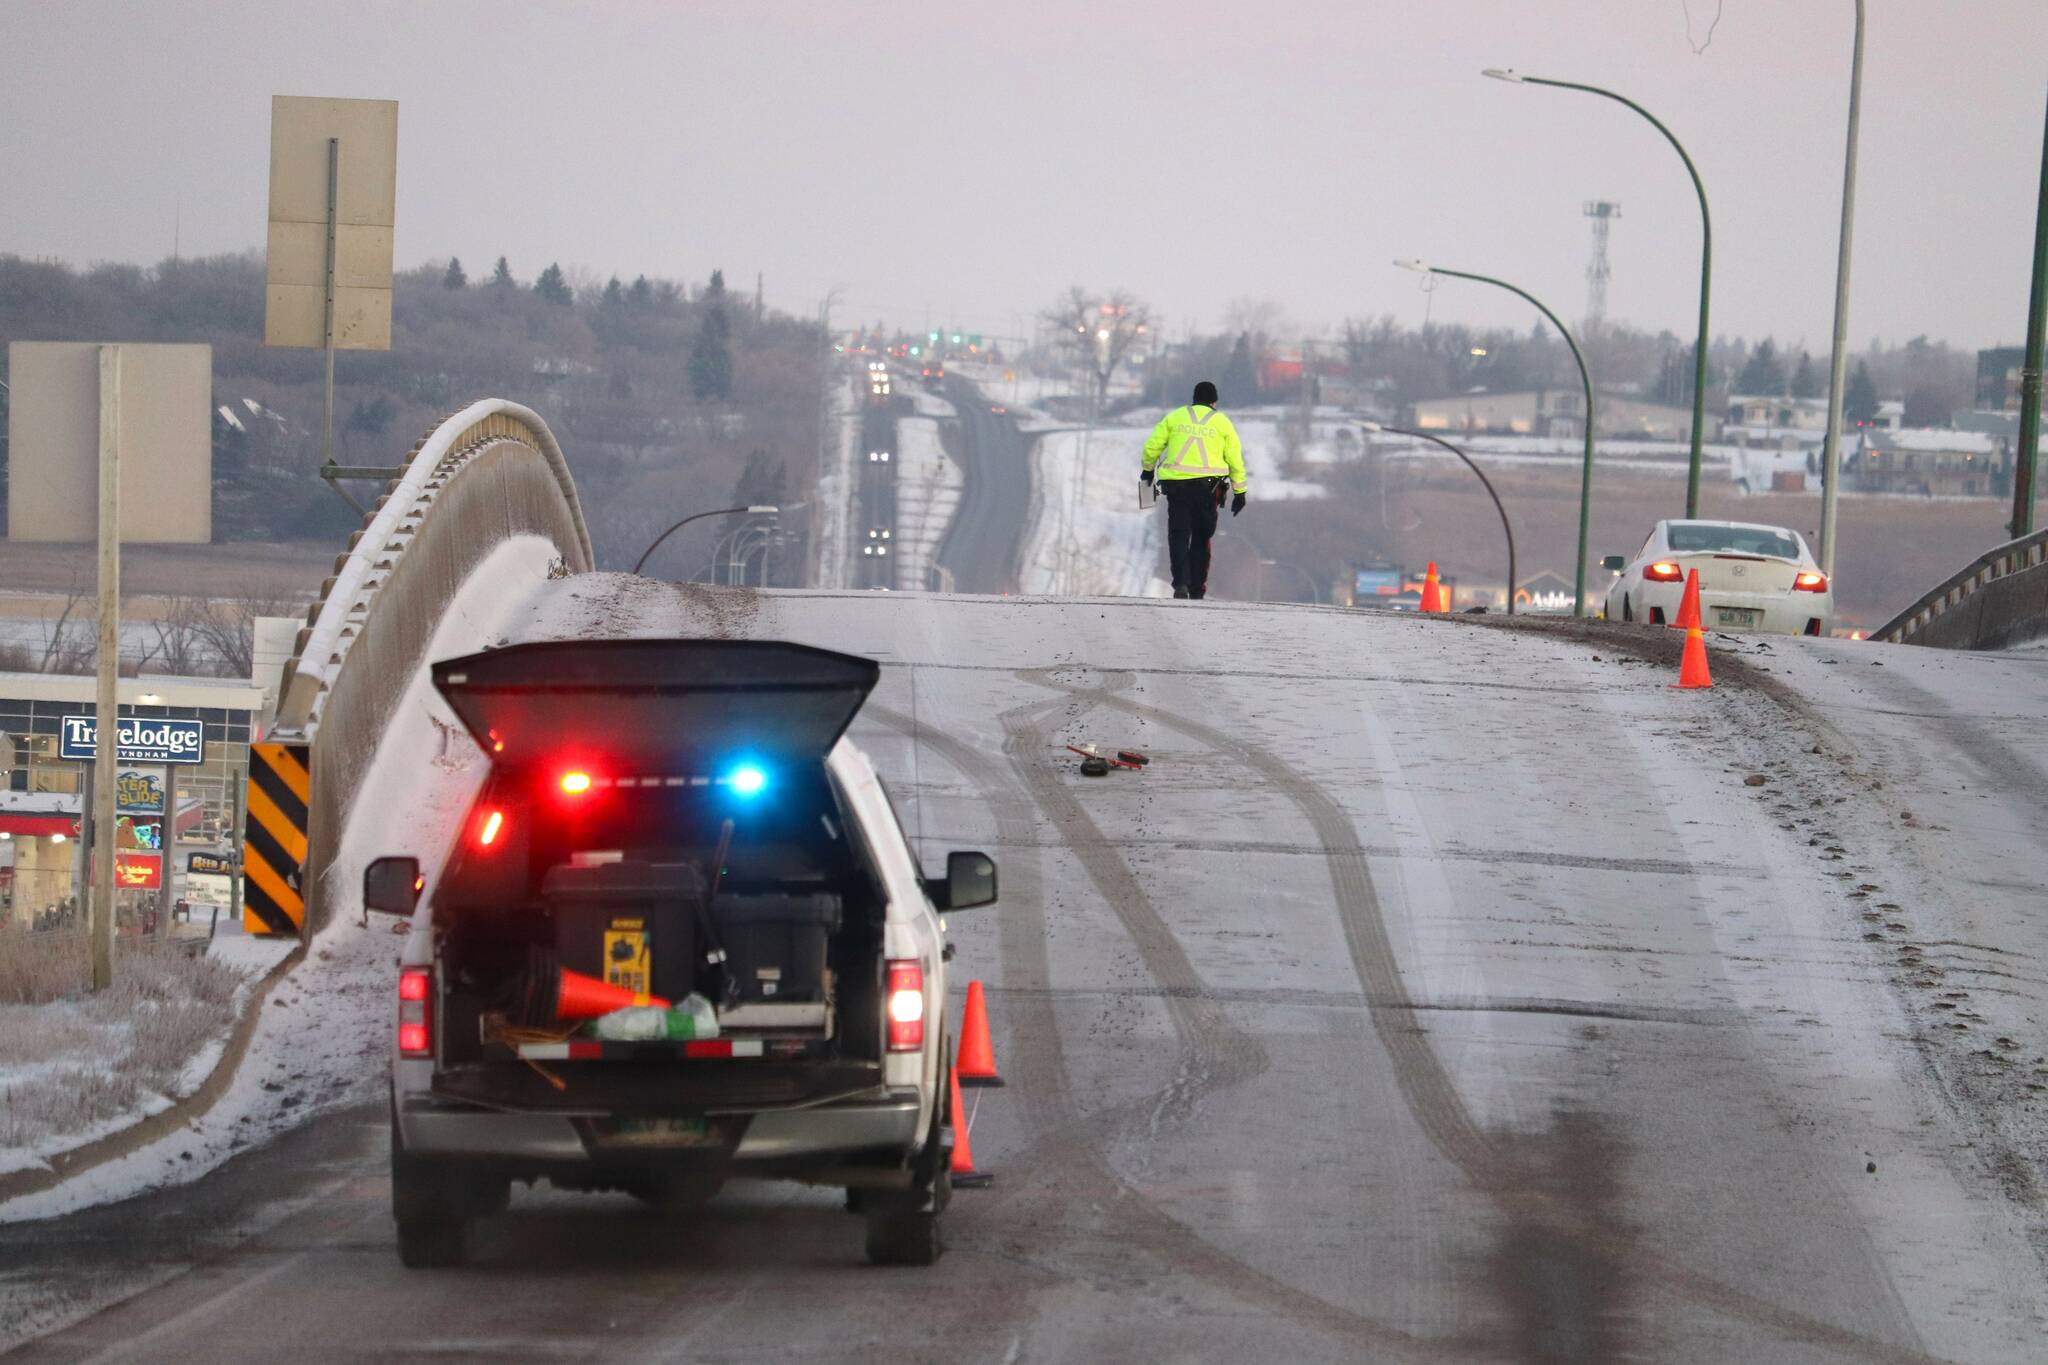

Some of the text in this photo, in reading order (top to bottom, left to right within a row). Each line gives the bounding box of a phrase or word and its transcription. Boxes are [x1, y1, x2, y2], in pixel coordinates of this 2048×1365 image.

[1177, 423, 1215, 439] POLICE
[66, 719, 198, 753] Trelodge
[117, 750, 168, 759] YNDHAM
[119, 791, 160, 805] SLIDE
